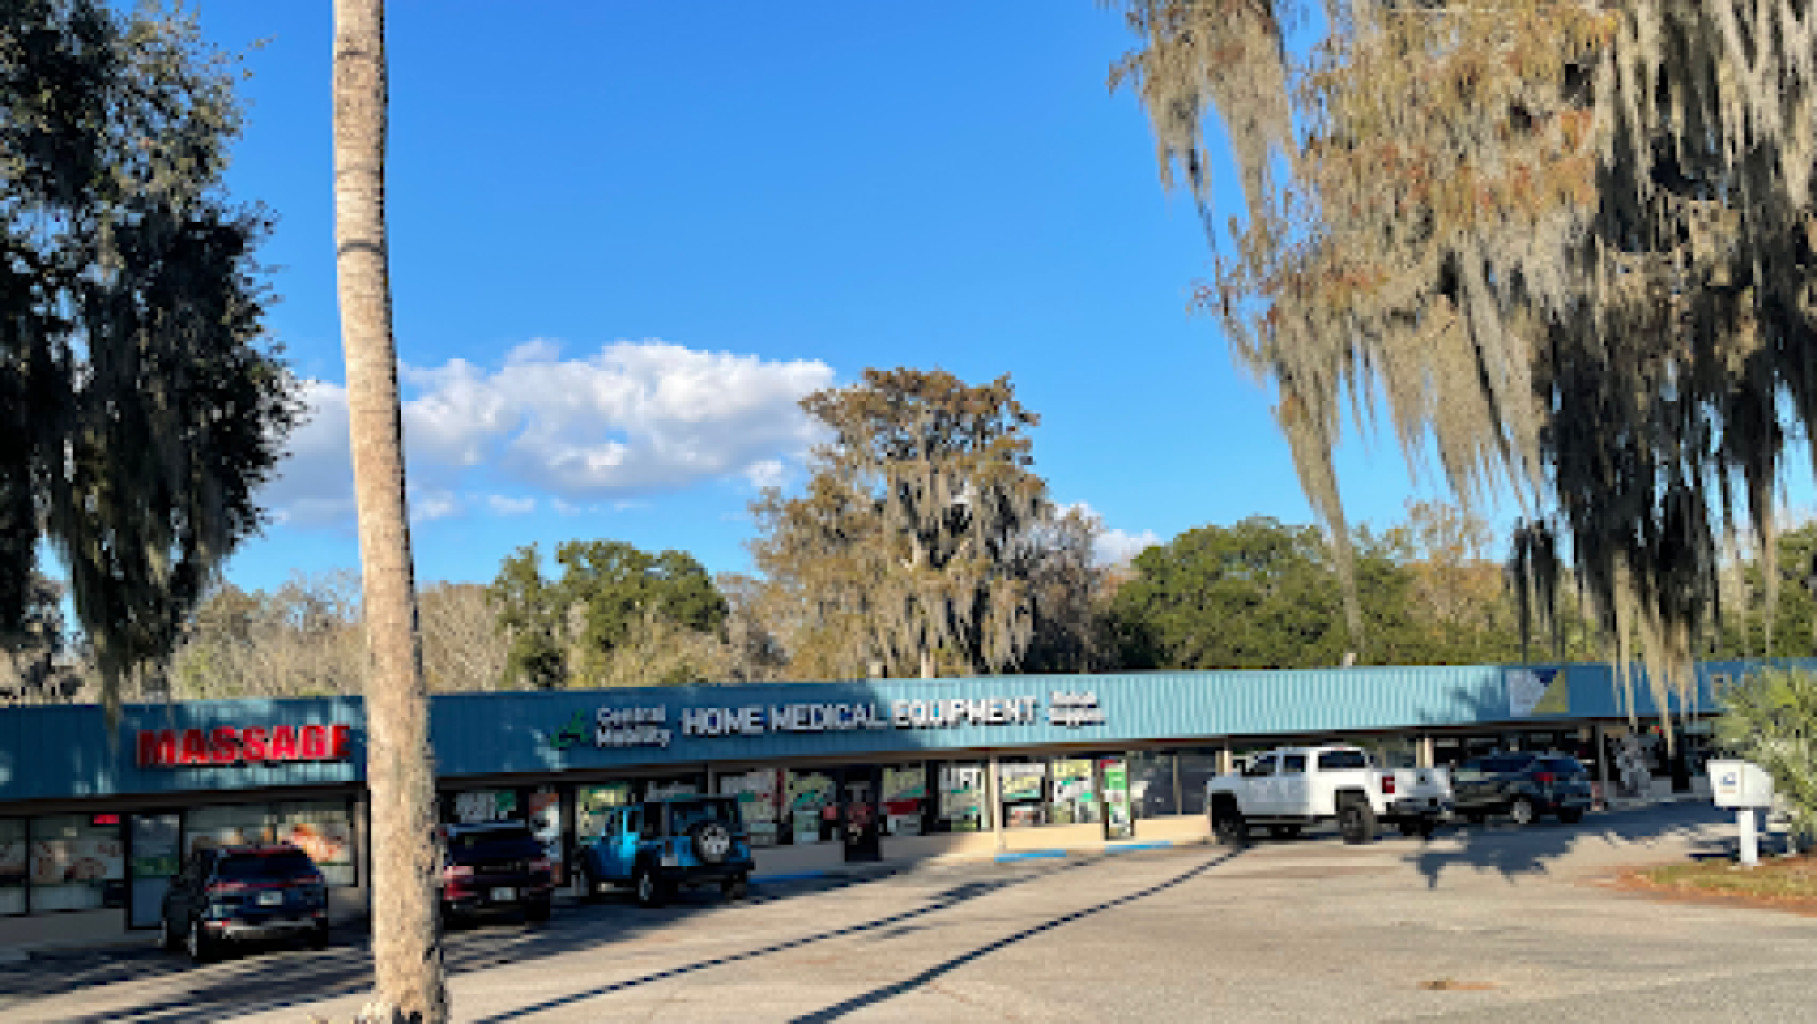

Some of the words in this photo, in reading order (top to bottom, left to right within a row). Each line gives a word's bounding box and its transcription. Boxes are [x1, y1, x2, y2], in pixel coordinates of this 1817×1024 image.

[597, 705, 666, 725] Central
[682, 707, 763, 735] HOME
[771, 703, 887, 730] MEDICAL
[890, 696, 1037, 726] EQUIPMENT
[137, 724, 351, 766] MASSAGE
[596, 725, 670, 748] Mobility
